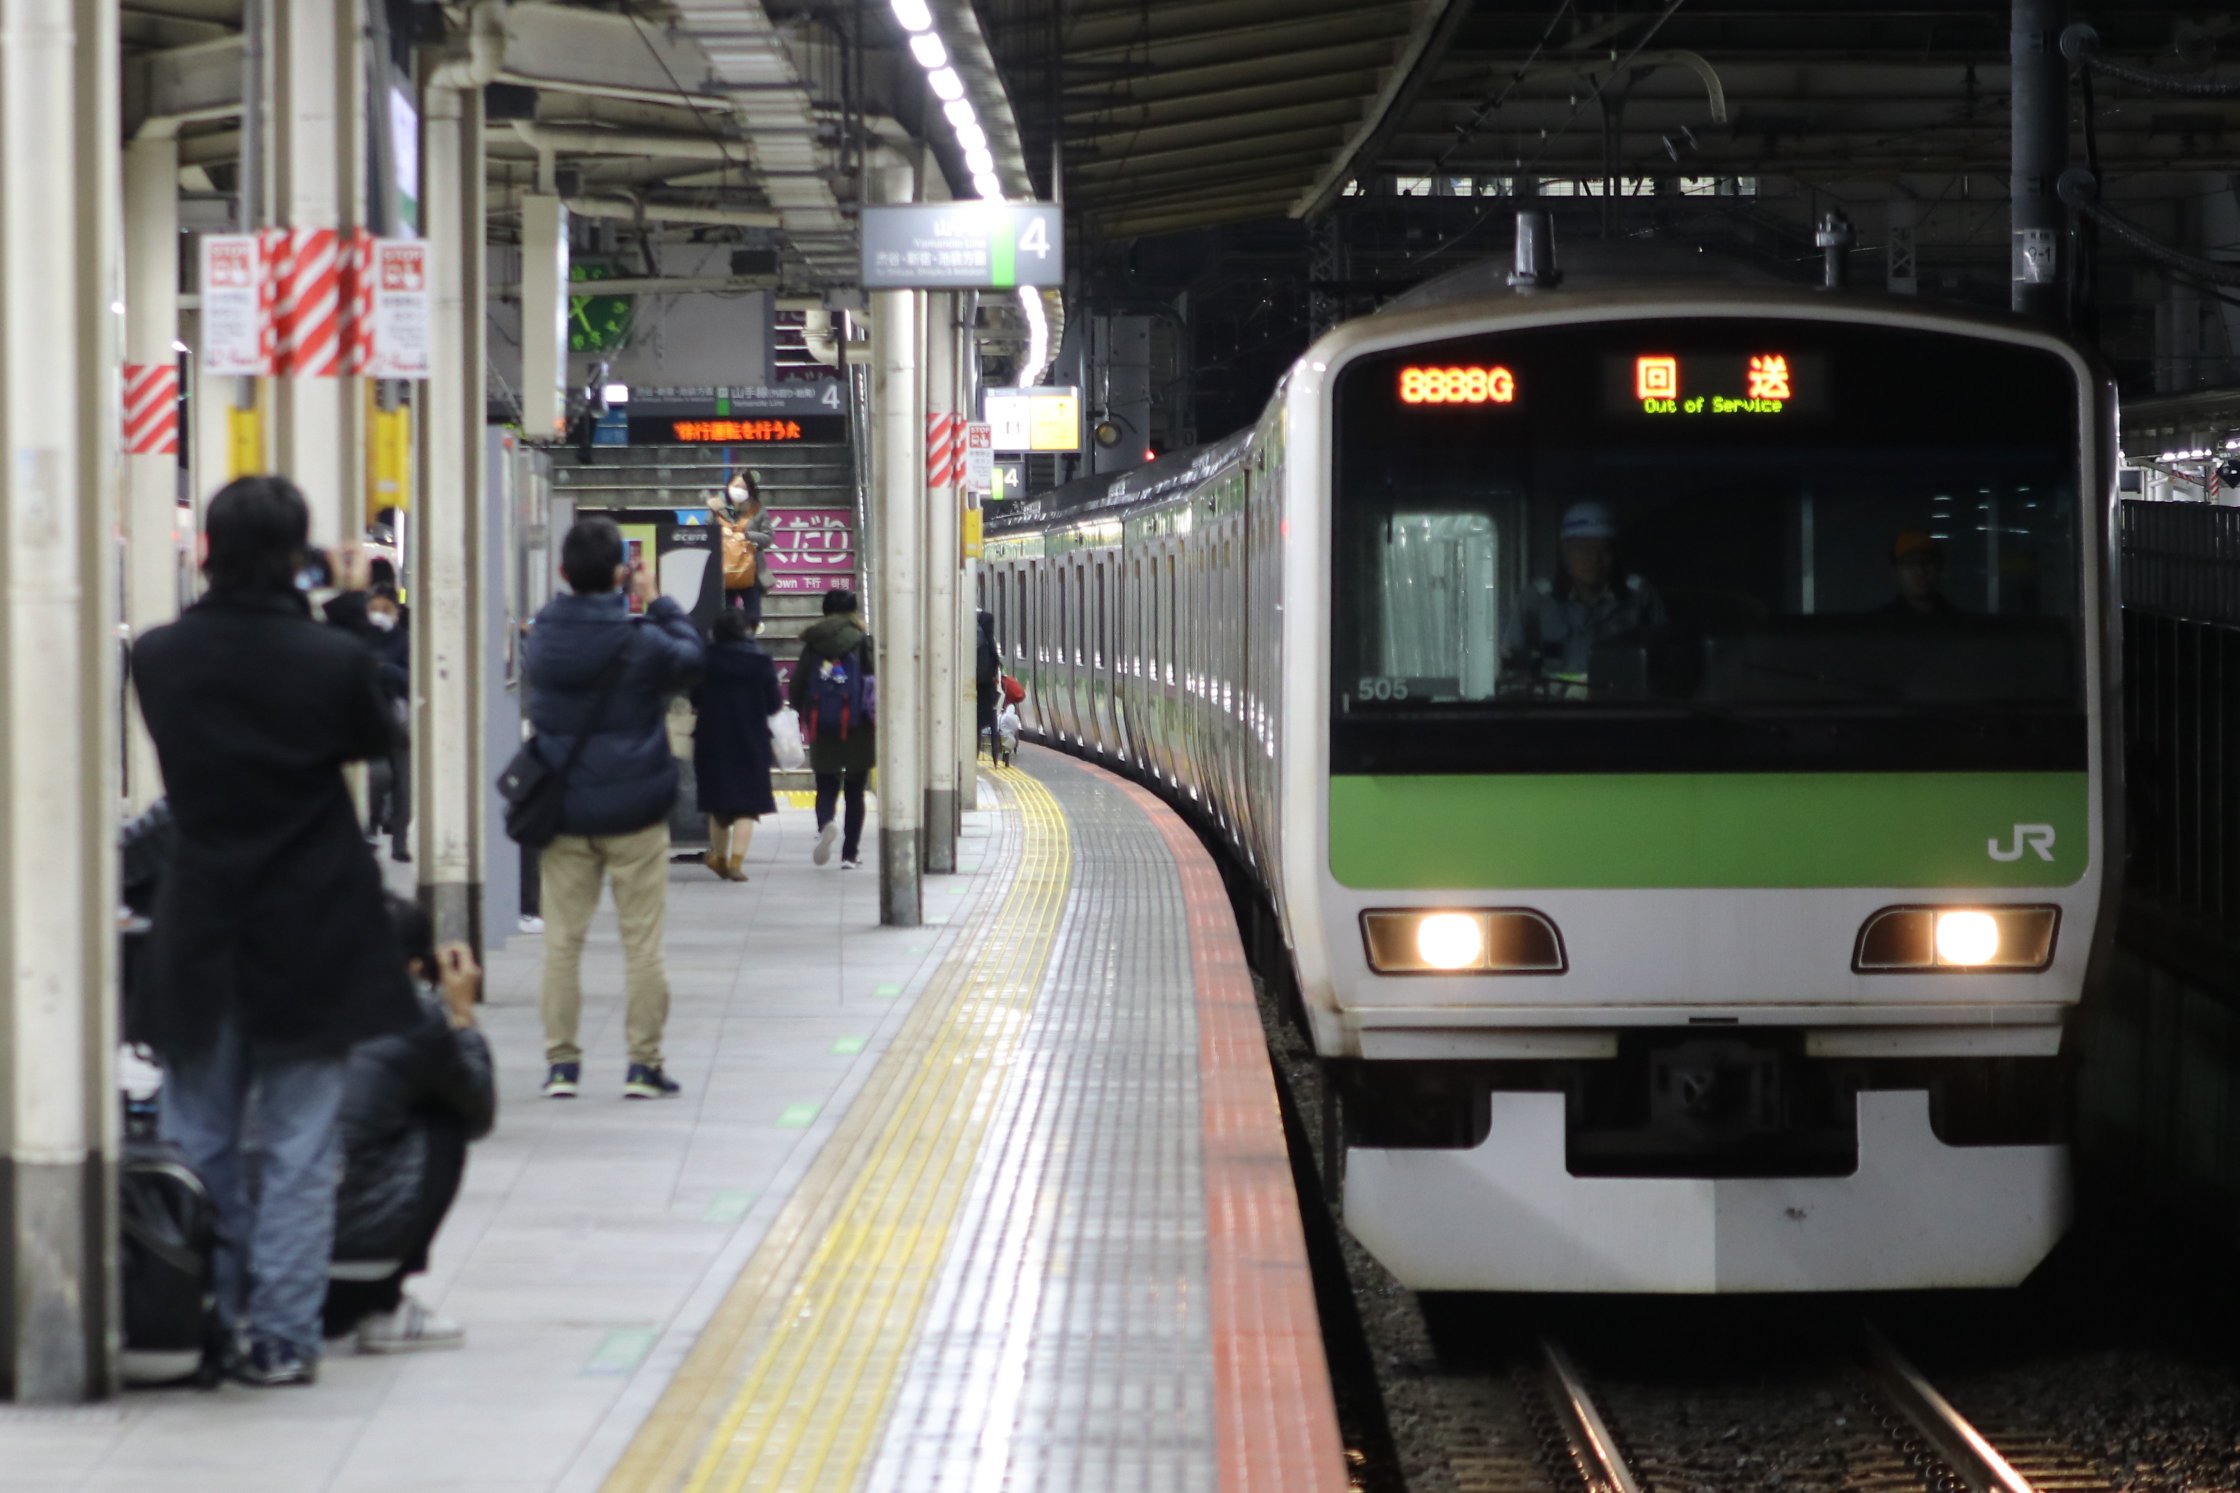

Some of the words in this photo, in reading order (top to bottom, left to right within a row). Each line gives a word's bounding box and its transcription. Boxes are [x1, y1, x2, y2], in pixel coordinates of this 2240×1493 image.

[1018, 216, 1050, 259] 4
[821, 384, 840, 409] 4
[1400, 366, 1513, 403] 8888G
[1644, 398, 1677, 413] Out
[1684, 396, 1704, 413] of
[1712, 396, 1783, 413] Service
[1004, 467, 1019, 488] 4
[770, 515, 849, 564] くだり
[1358, 678, 1408, 701] 505
[1987, 823, 2056, 862] JR
